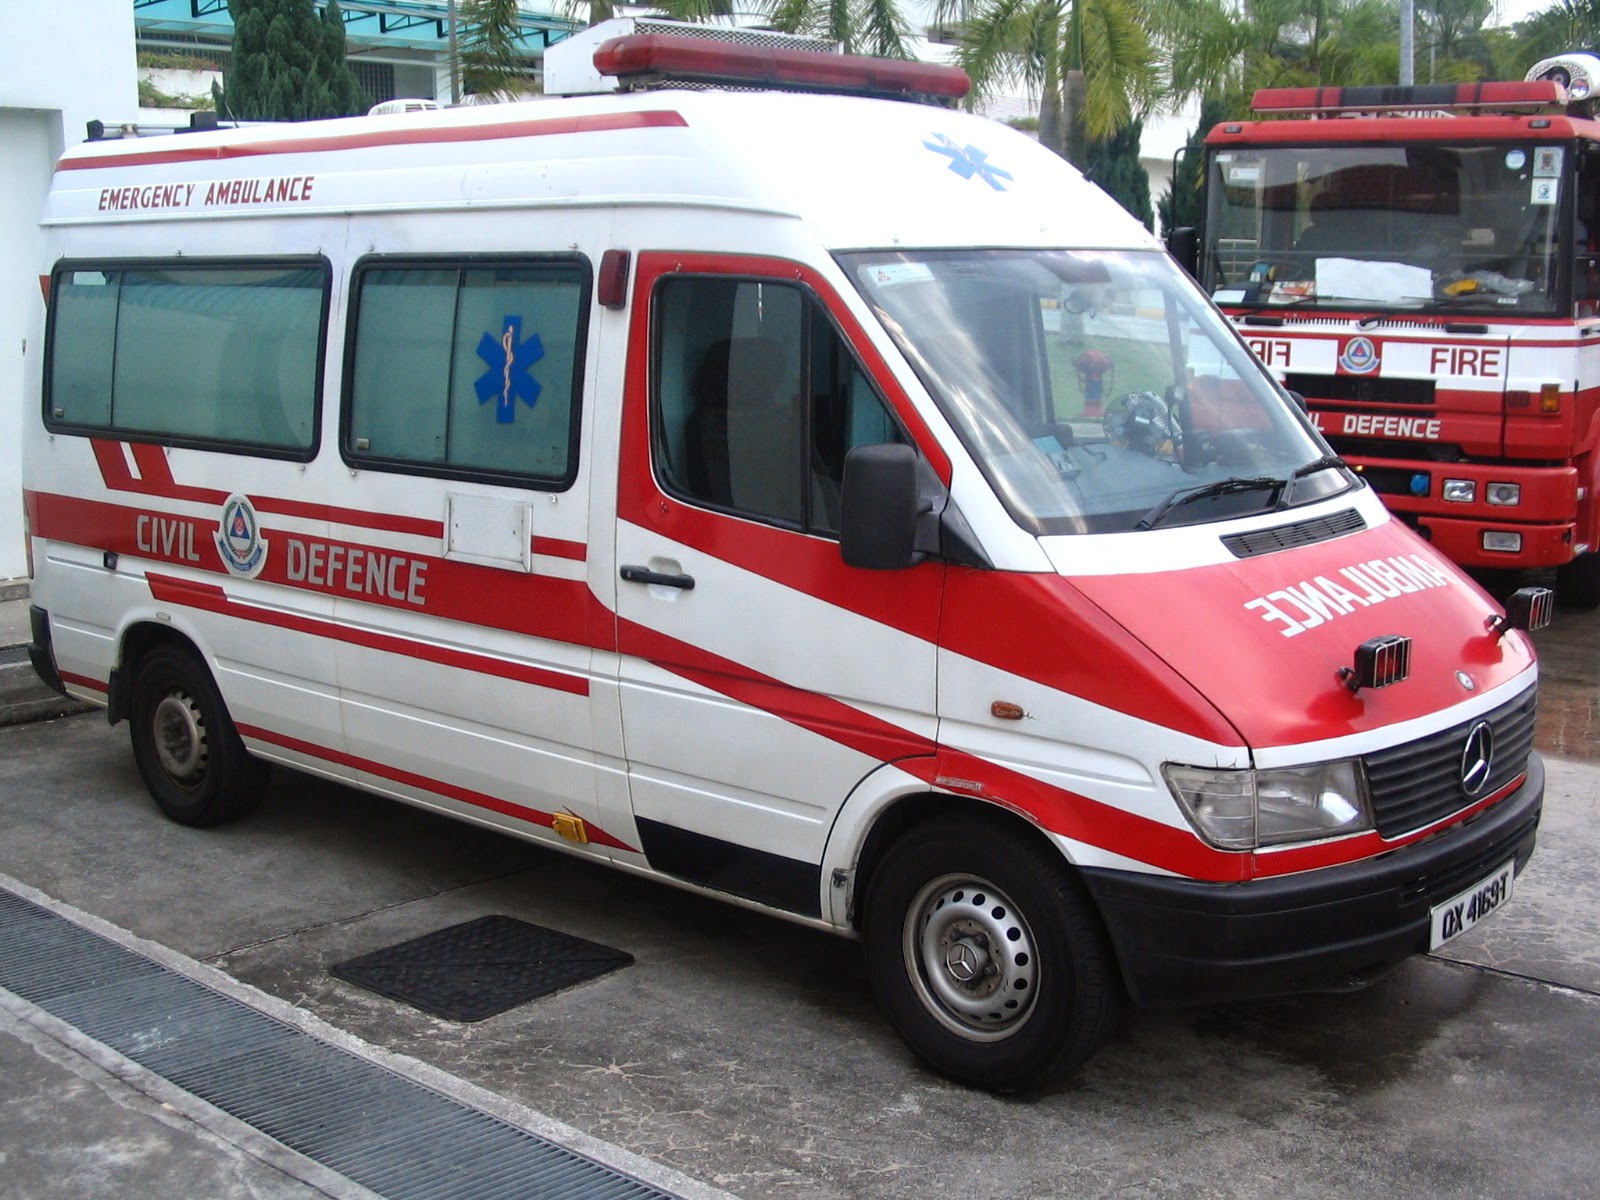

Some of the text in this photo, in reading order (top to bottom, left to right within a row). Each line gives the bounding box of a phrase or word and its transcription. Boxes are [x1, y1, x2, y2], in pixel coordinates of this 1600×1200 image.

[98, 176, 315, 211] EMERGENCY AMBULANCE
[1430, 347, 1500, 377] FIRE
[1343, 414, 1441, 439] DEFENCE
[136, 514, 200, 561] CIVIL
[287, 538, 429, 605] DEFENCE
